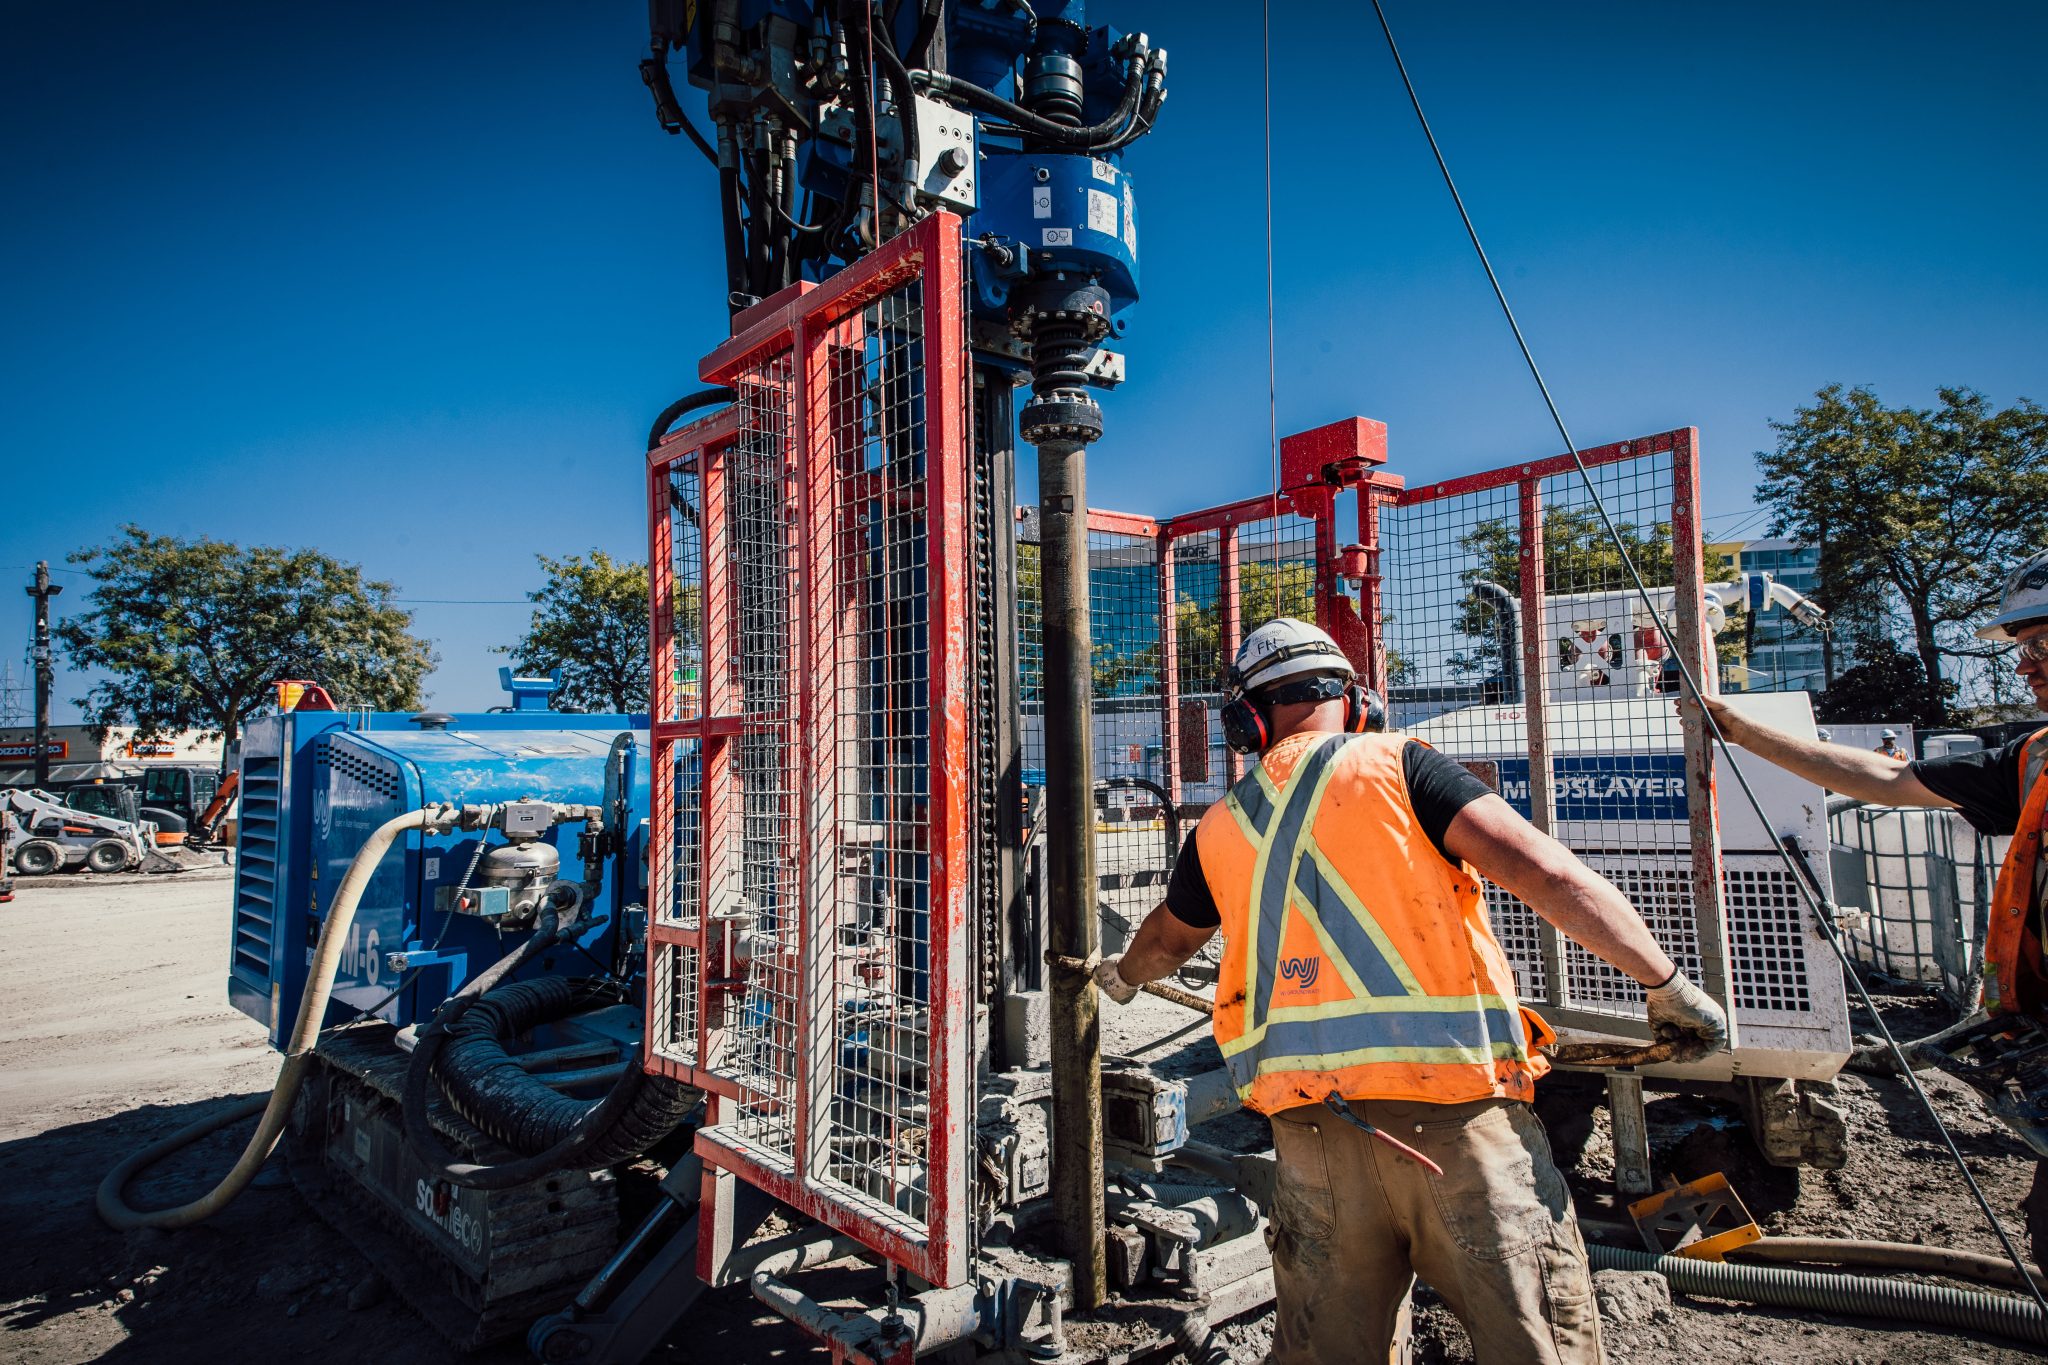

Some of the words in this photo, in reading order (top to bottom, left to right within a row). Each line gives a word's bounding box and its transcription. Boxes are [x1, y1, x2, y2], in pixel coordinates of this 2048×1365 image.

[347, 789, 372, 811] GROUP
[1503, 777, 1686, 800] MDSLAYER
[321, 921, 380, 986] M-6
